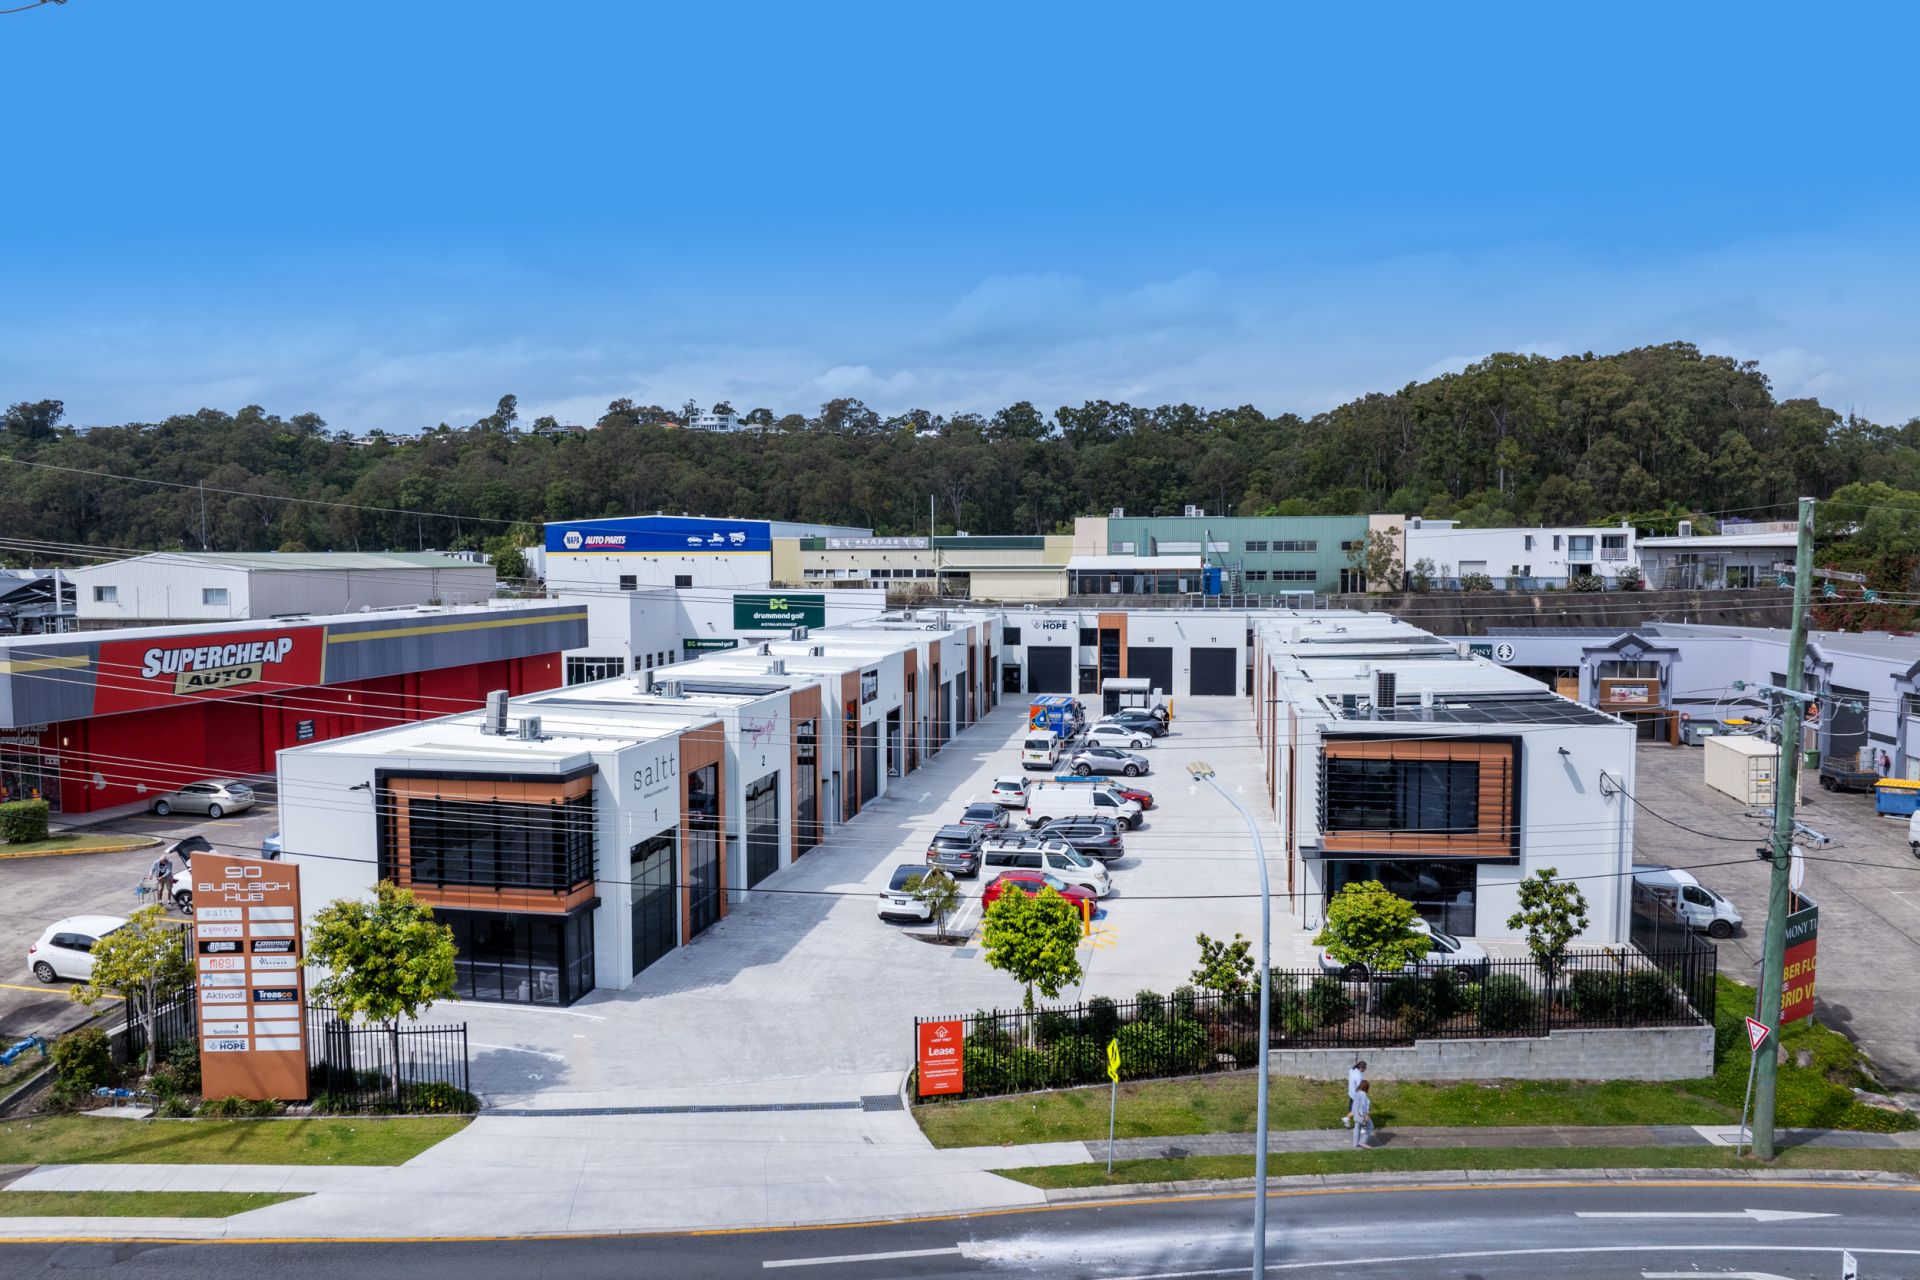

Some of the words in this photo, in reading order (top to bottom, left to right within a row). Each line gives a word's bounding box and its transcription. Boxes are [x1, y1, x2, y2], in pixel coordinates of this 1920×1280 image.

[567, 534, 580, 544] NAPA
[585, 536, 604, 544] AUTO
[604, 535, 626, 544] PARTS
[770, 598, 788, 610] DG
[791, 612, 805, 620] golf
[141, 637, 293, 679] SUPERCHEAP
[186, 667, 252, 688] AUTO
[761, 754, 766, 767] 2
[633, 752, 676, 791] saltt
[653, 808, 658, 822] 1
[224, 866, 262, 878] 90
[224, 893, 264, 902] HUB
[928, 1047, 955, 1056] Lease
